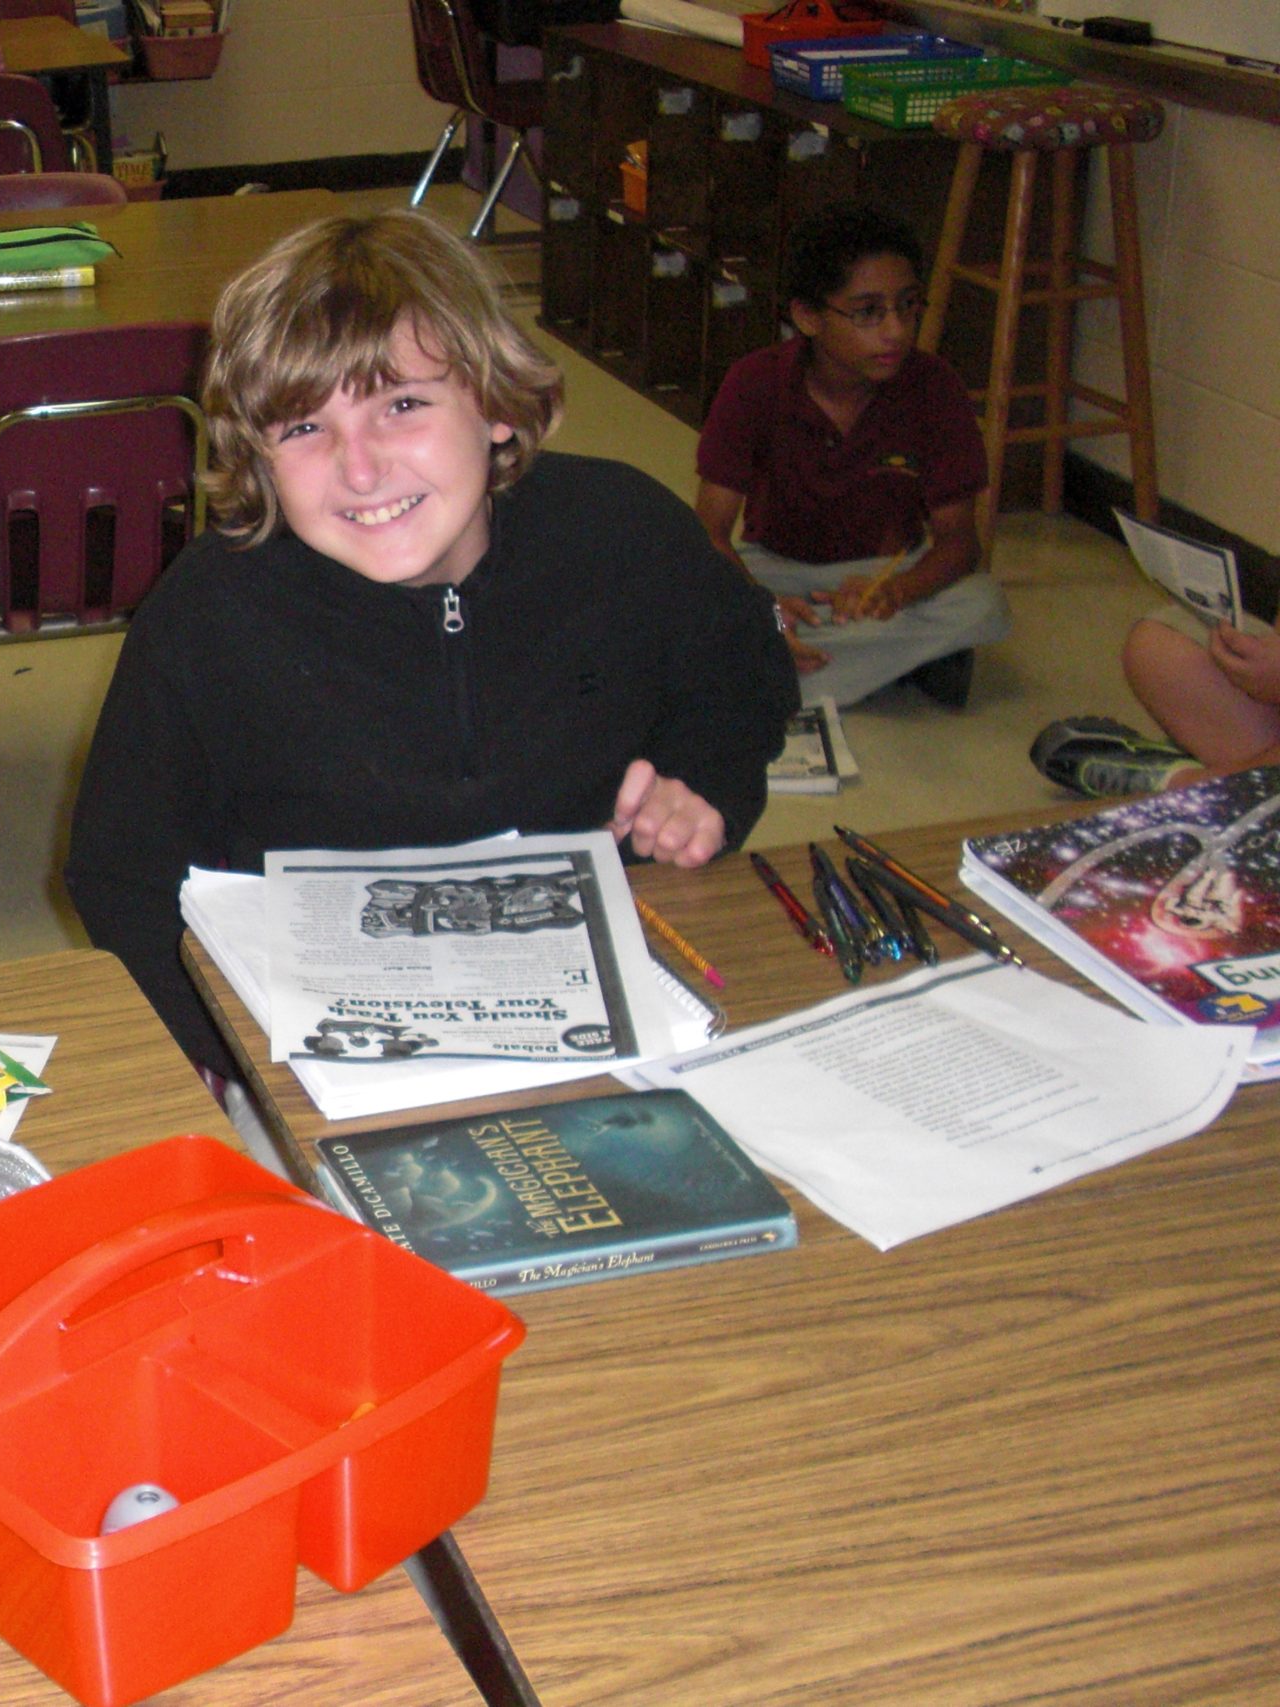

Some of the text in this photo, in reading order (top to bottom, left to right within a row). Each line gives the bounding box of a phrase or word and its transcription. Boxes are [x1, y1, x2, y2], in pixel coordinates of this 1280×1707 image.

[327, 1005, 569, 1023] Should You Trash
[335, 997, 557, 1011] Your Television?
[492, 1043, 559, 1053] Debate
[499, 1117, 624, 1235] ELEPHANT
[382, 1223, 416, 1254] ATE
[519, 1268, 541, 1284] The
[544, 1256, 604, 1280] Magician's
[607, 1252, 655, 1270] Elephant
